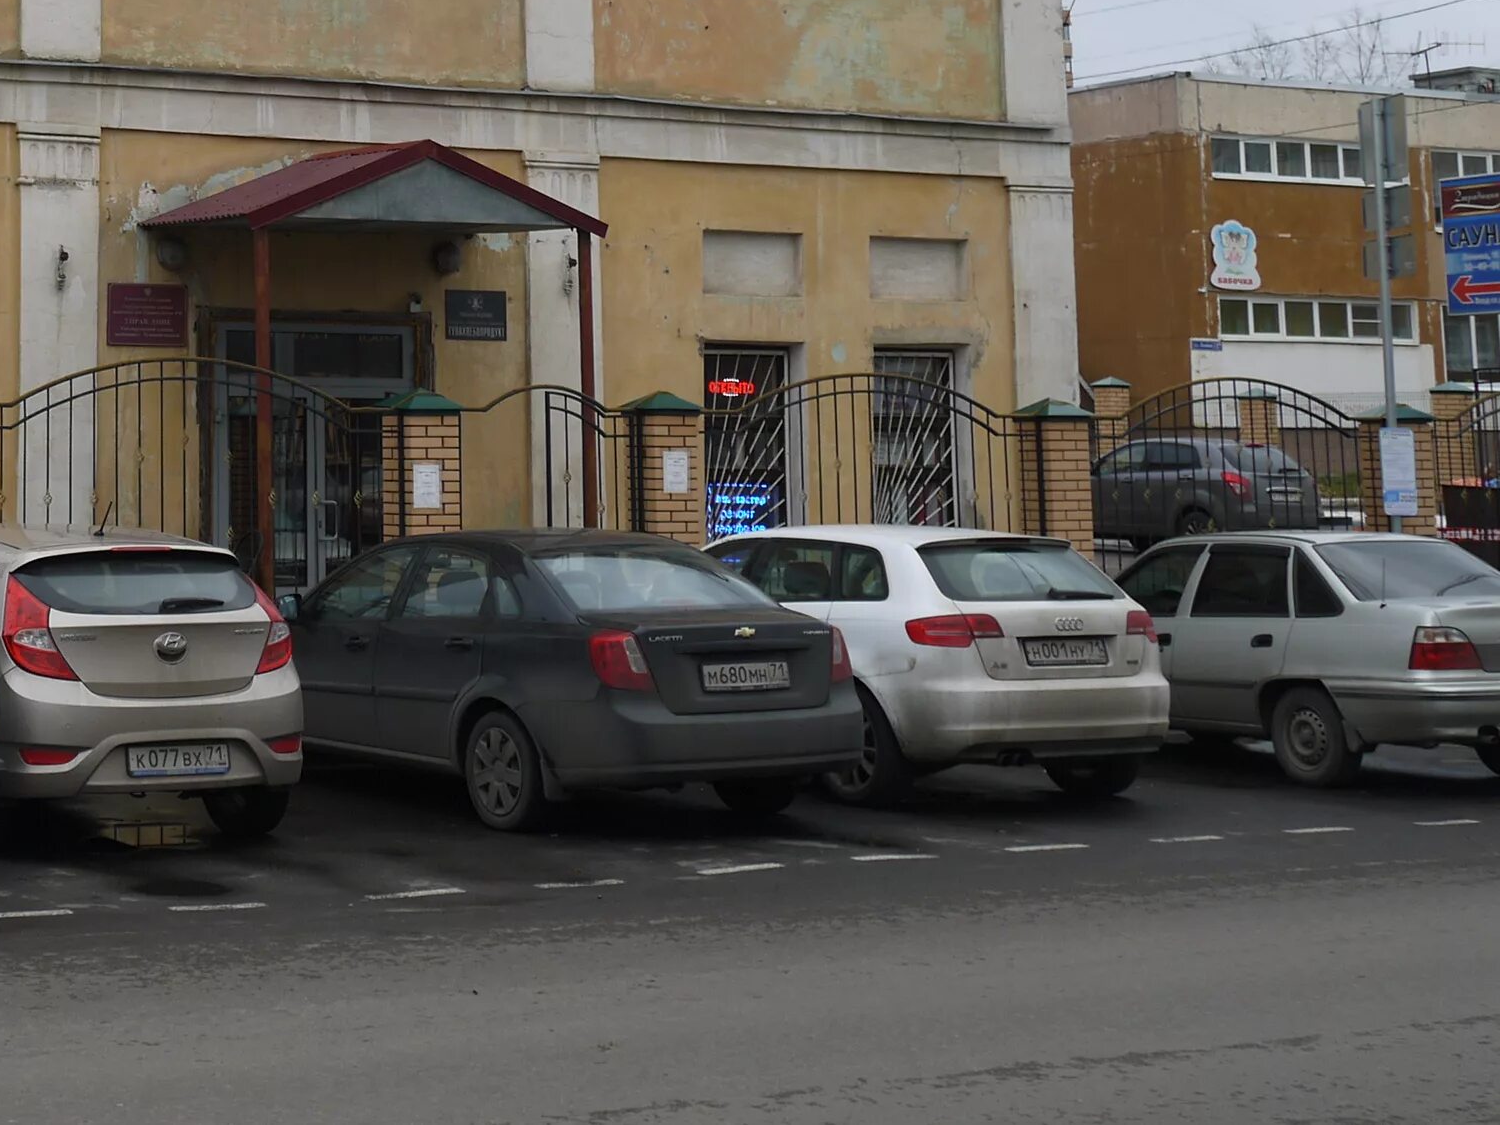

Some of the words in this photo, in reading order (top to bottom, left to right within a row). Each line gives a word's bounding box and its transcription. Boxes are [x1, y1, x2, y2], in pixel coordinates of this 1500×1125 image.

[708, 381, 755, 394] ОТКРЫТО
[769, 663, 785, 678] 71
[206, 746, 223, 761] 71
